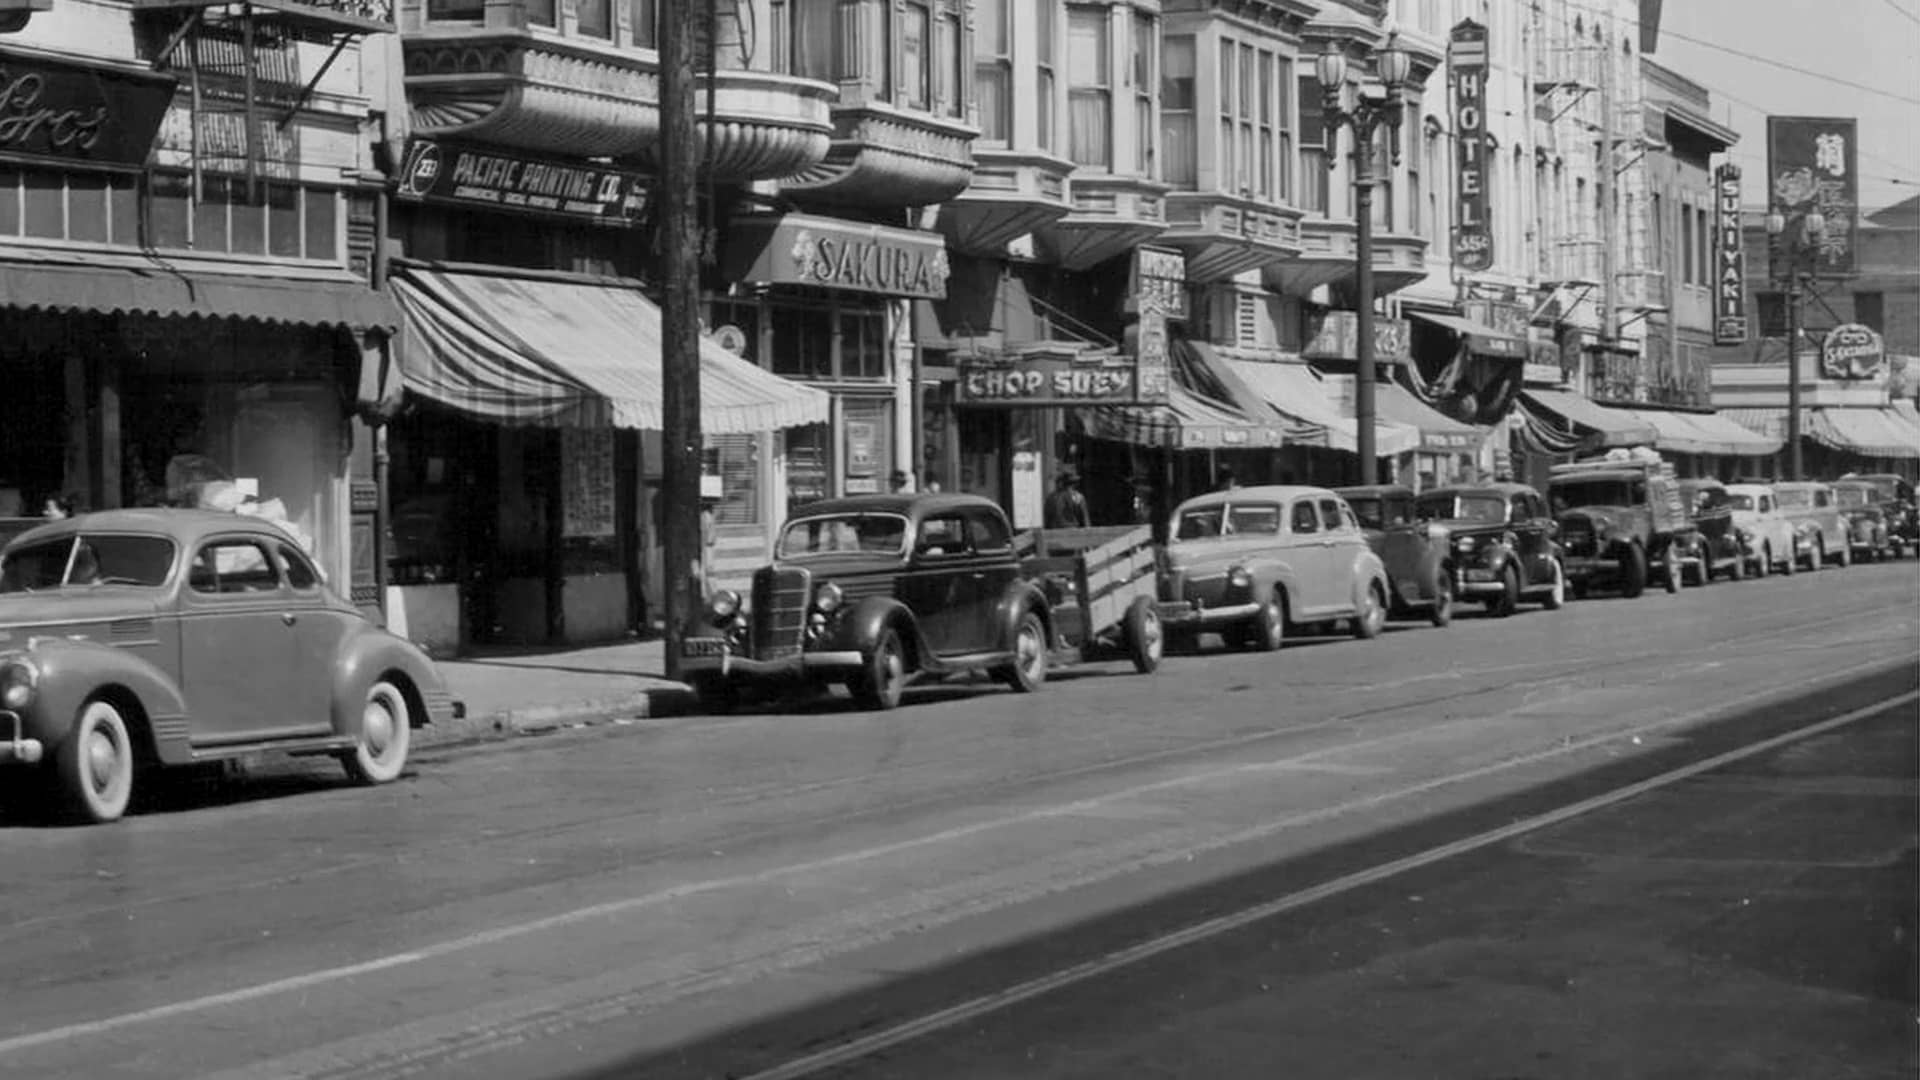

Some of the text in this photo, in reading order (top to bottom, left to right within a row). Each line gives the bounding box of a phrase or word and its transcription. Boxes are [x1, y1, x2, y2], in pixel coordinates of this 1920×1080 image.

[452, 153, 520, 189] PACIFIC
[519, 163, 597, 200] PRINTING
[1458, 74, 1482, 226] HOTEL
[814, 237, 929, 293] SAKURA
[1721, 181, 1739, 315] SUKIYAKI
[966, 370, 1130, 396] CHOP SUEY
